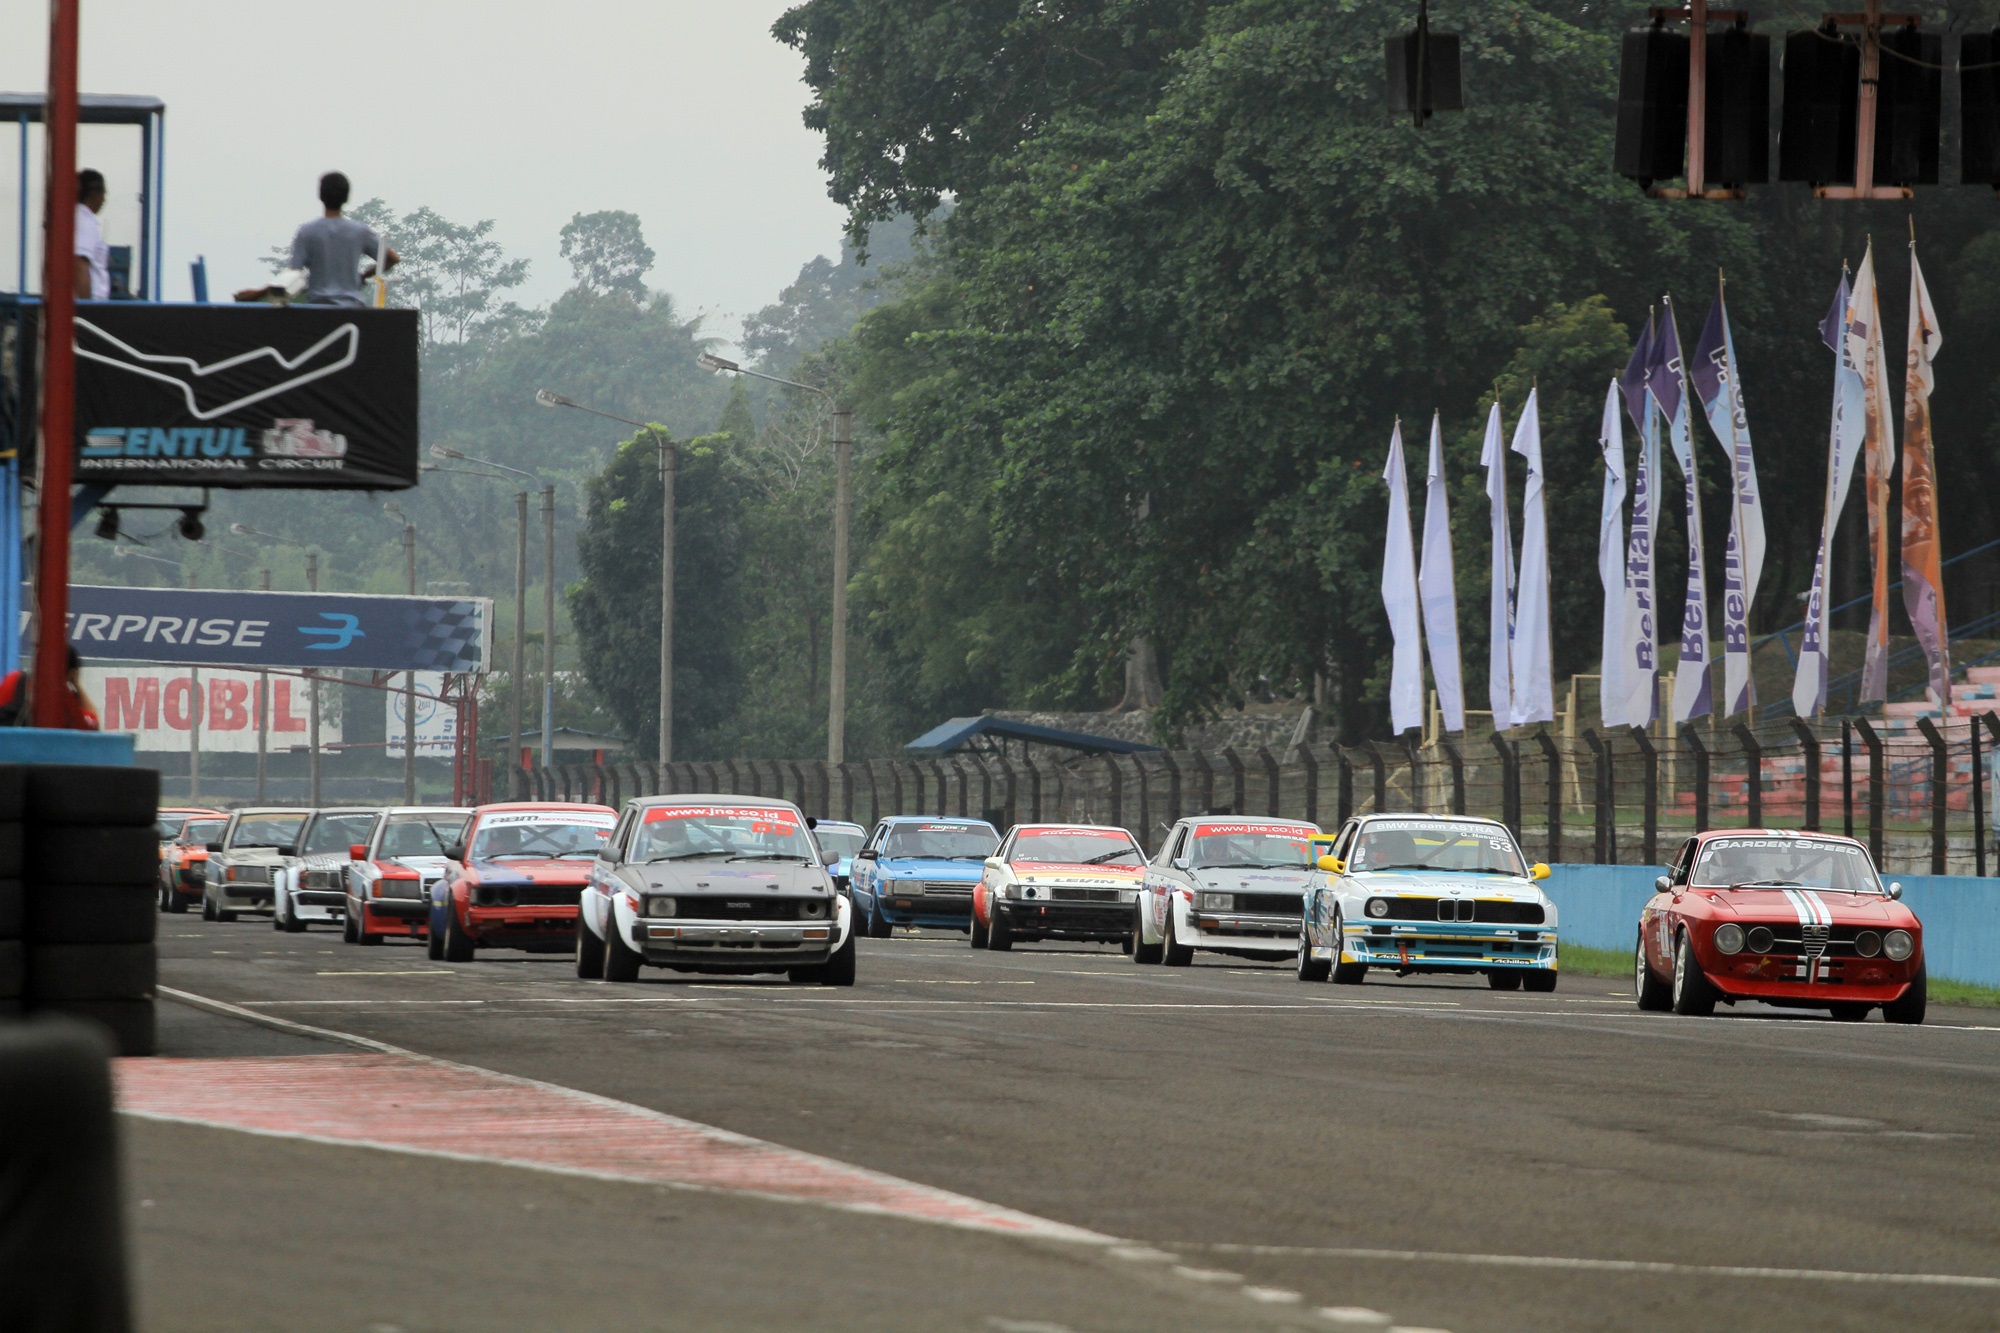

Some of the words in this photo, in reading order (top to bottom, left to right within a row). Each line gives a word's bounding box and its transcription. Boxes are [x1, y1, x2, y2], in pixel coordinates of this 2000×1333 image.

[80, 426, 253, 457] SENTUL
[80, 458, 248, 470] INTERNATIONAL
[258, 458, 345, 470] CIRCUIT
[104, 676, 306, 732] MOBIL
[665, 807, 779, 820] www.jne.co.id
[1211, 825, 1304, 835] www.jne.co.id
[1376, 822, 1409, 831] BMW
[1414, 822, 1446, 830] Team
[1450, 823, 1494, 834] ASTRA
[1472, 833, 1510, 843] Nasution
[1489, 840, 1513, 853] 53
[1711, 839, 1791, 851] GARDEN
[1795, 839, 1859, 855] SPEED
